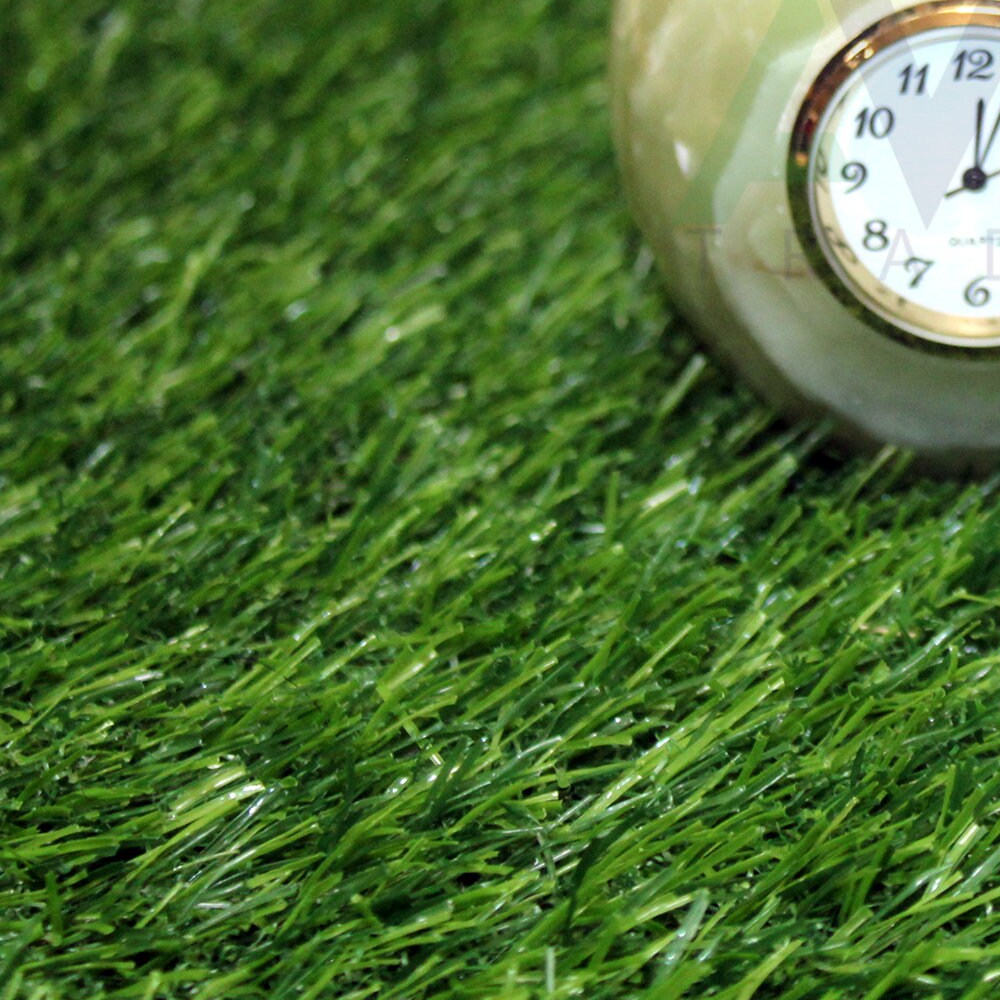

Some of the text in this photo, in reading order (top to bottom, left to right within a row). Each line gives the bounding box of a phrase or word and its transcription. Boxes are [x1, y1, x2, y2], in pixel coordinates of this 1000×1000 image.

[898, 63, 930, 96] 11
[952, 48, 995, 81] 12
[854, 106, 896, 140] 10
[840, 161, 868, 195] 9
[862, 219, 889, 252] 8
[903, 256, 935, 289] 7
[963, 275, 991, 308] 6
